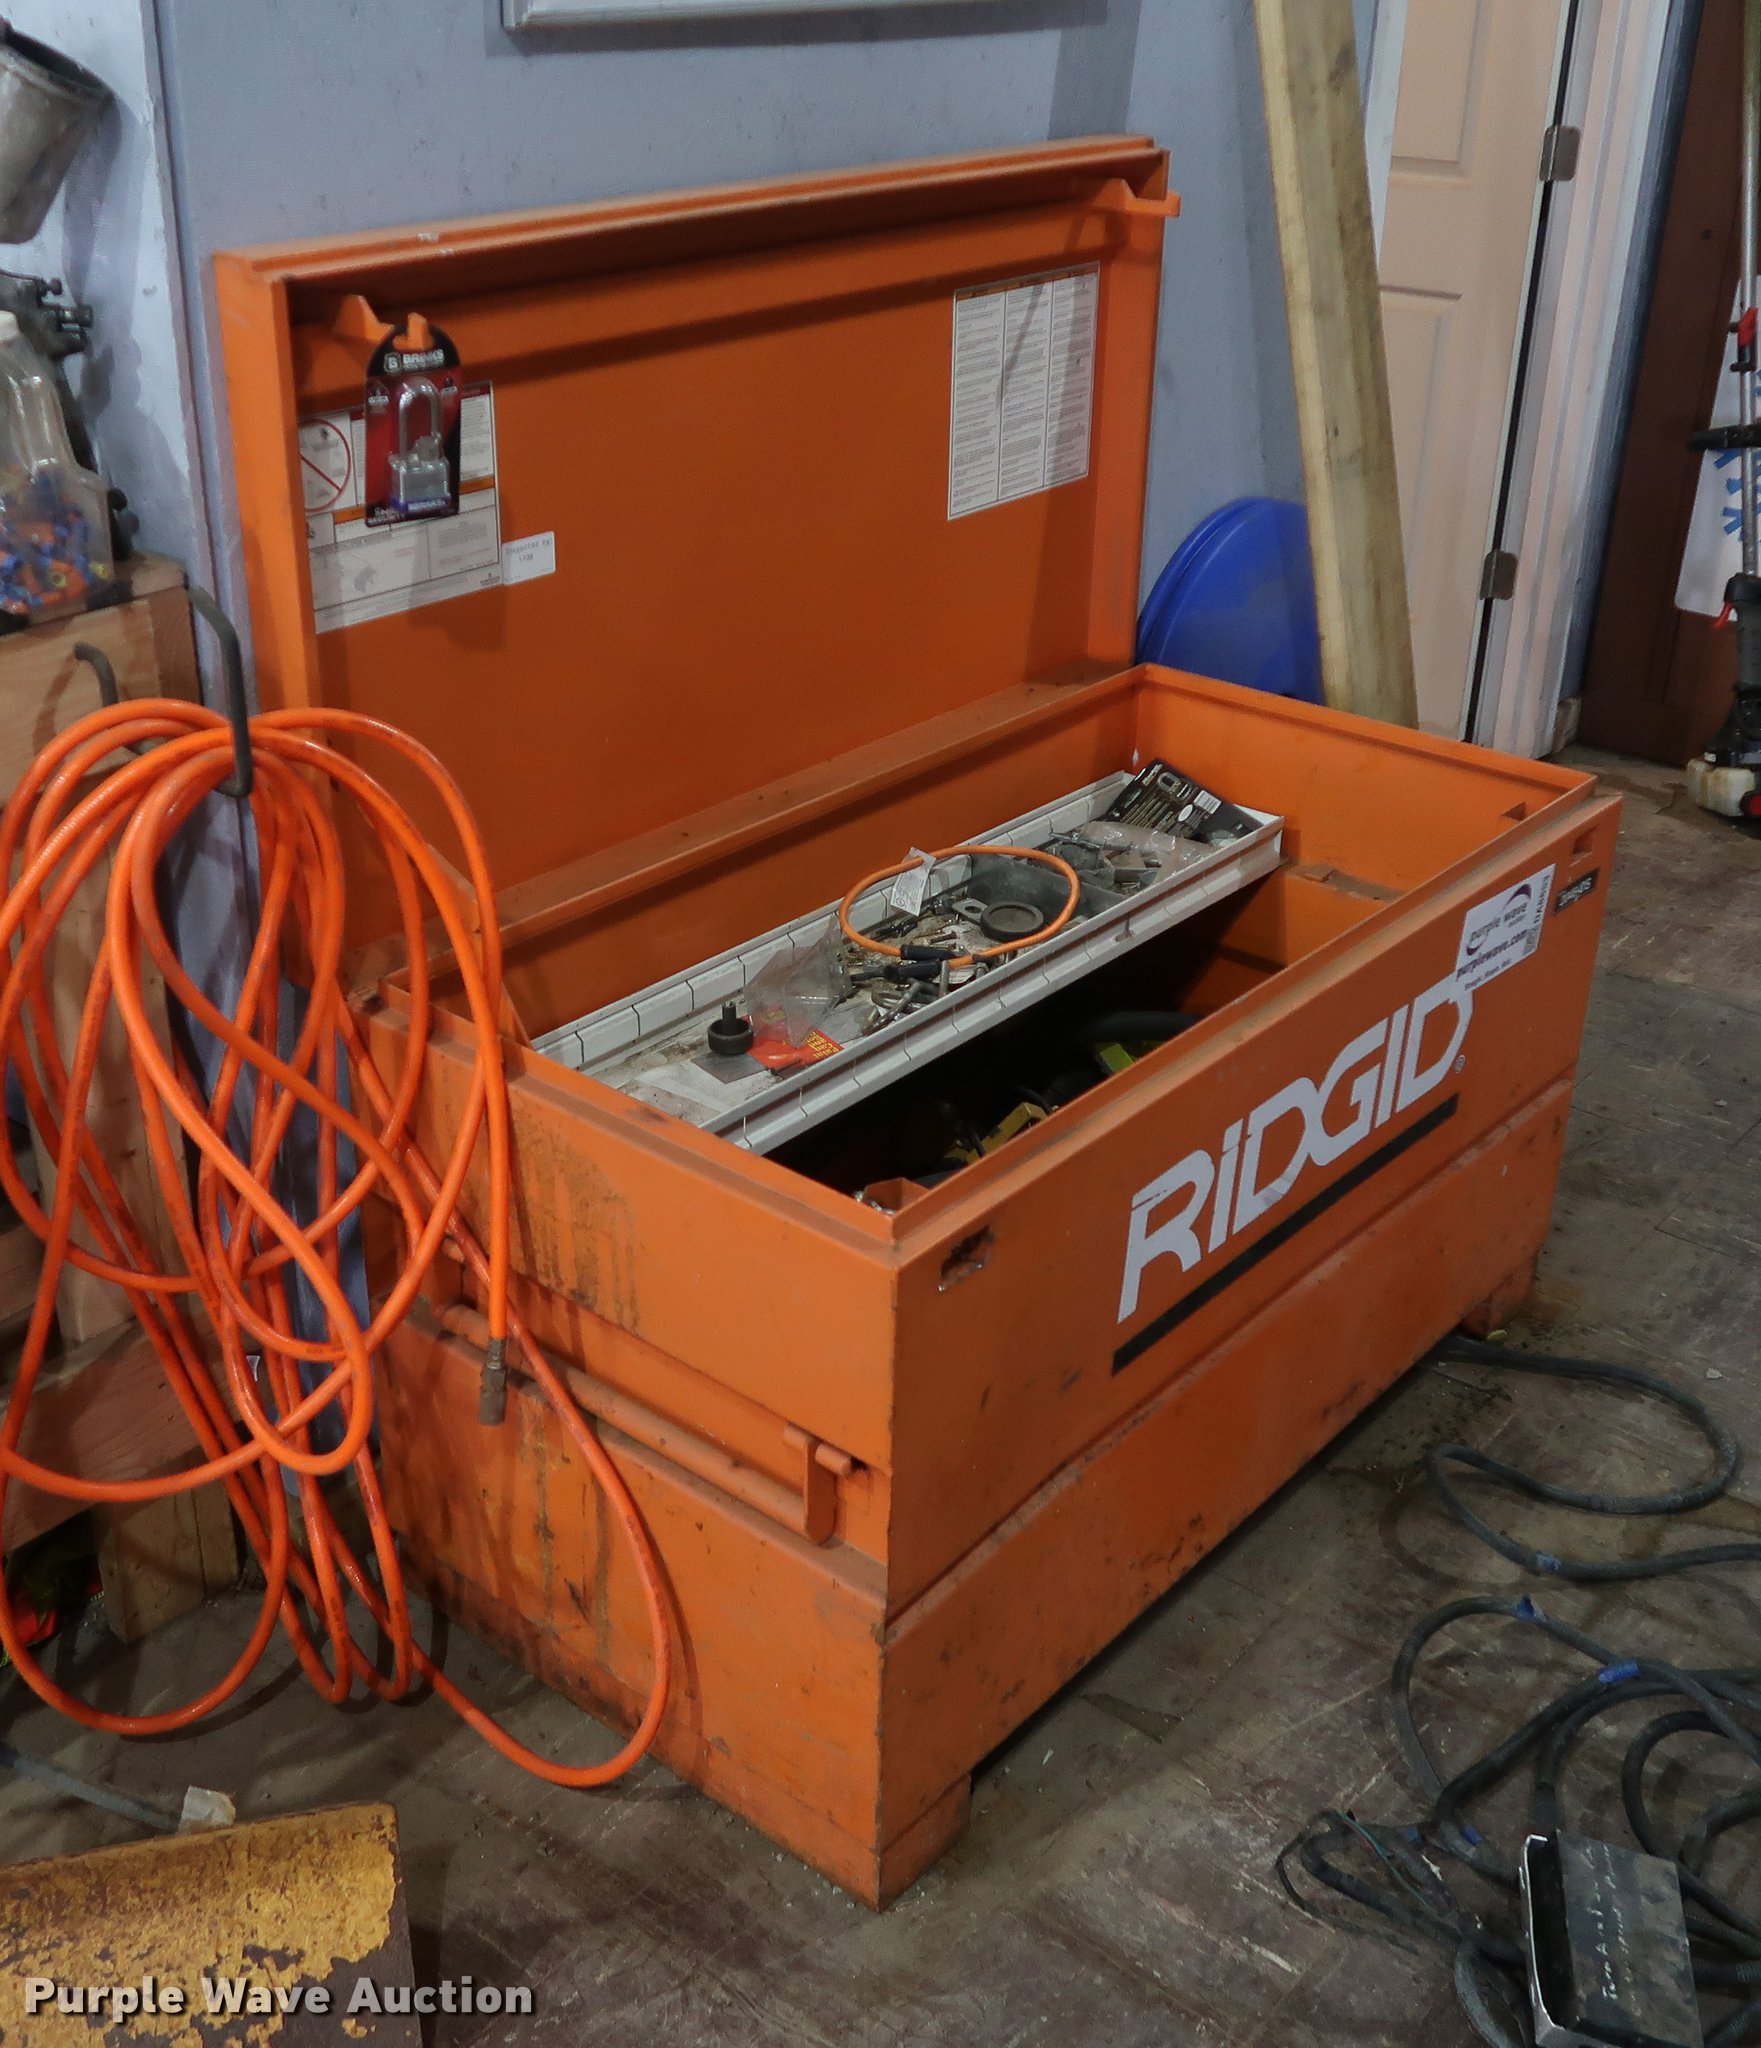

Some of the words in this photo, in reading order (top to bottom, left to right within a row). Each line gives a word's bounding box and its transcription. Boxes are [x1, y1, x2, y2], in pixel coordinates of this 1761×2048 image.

[1470, 916, 1501, 944] purple
[1504, 902, 1528, 922] wave
[1456, 929, 1529, 981] purplewave.com
[1117, 976, 1473, 1324] RIDGID
